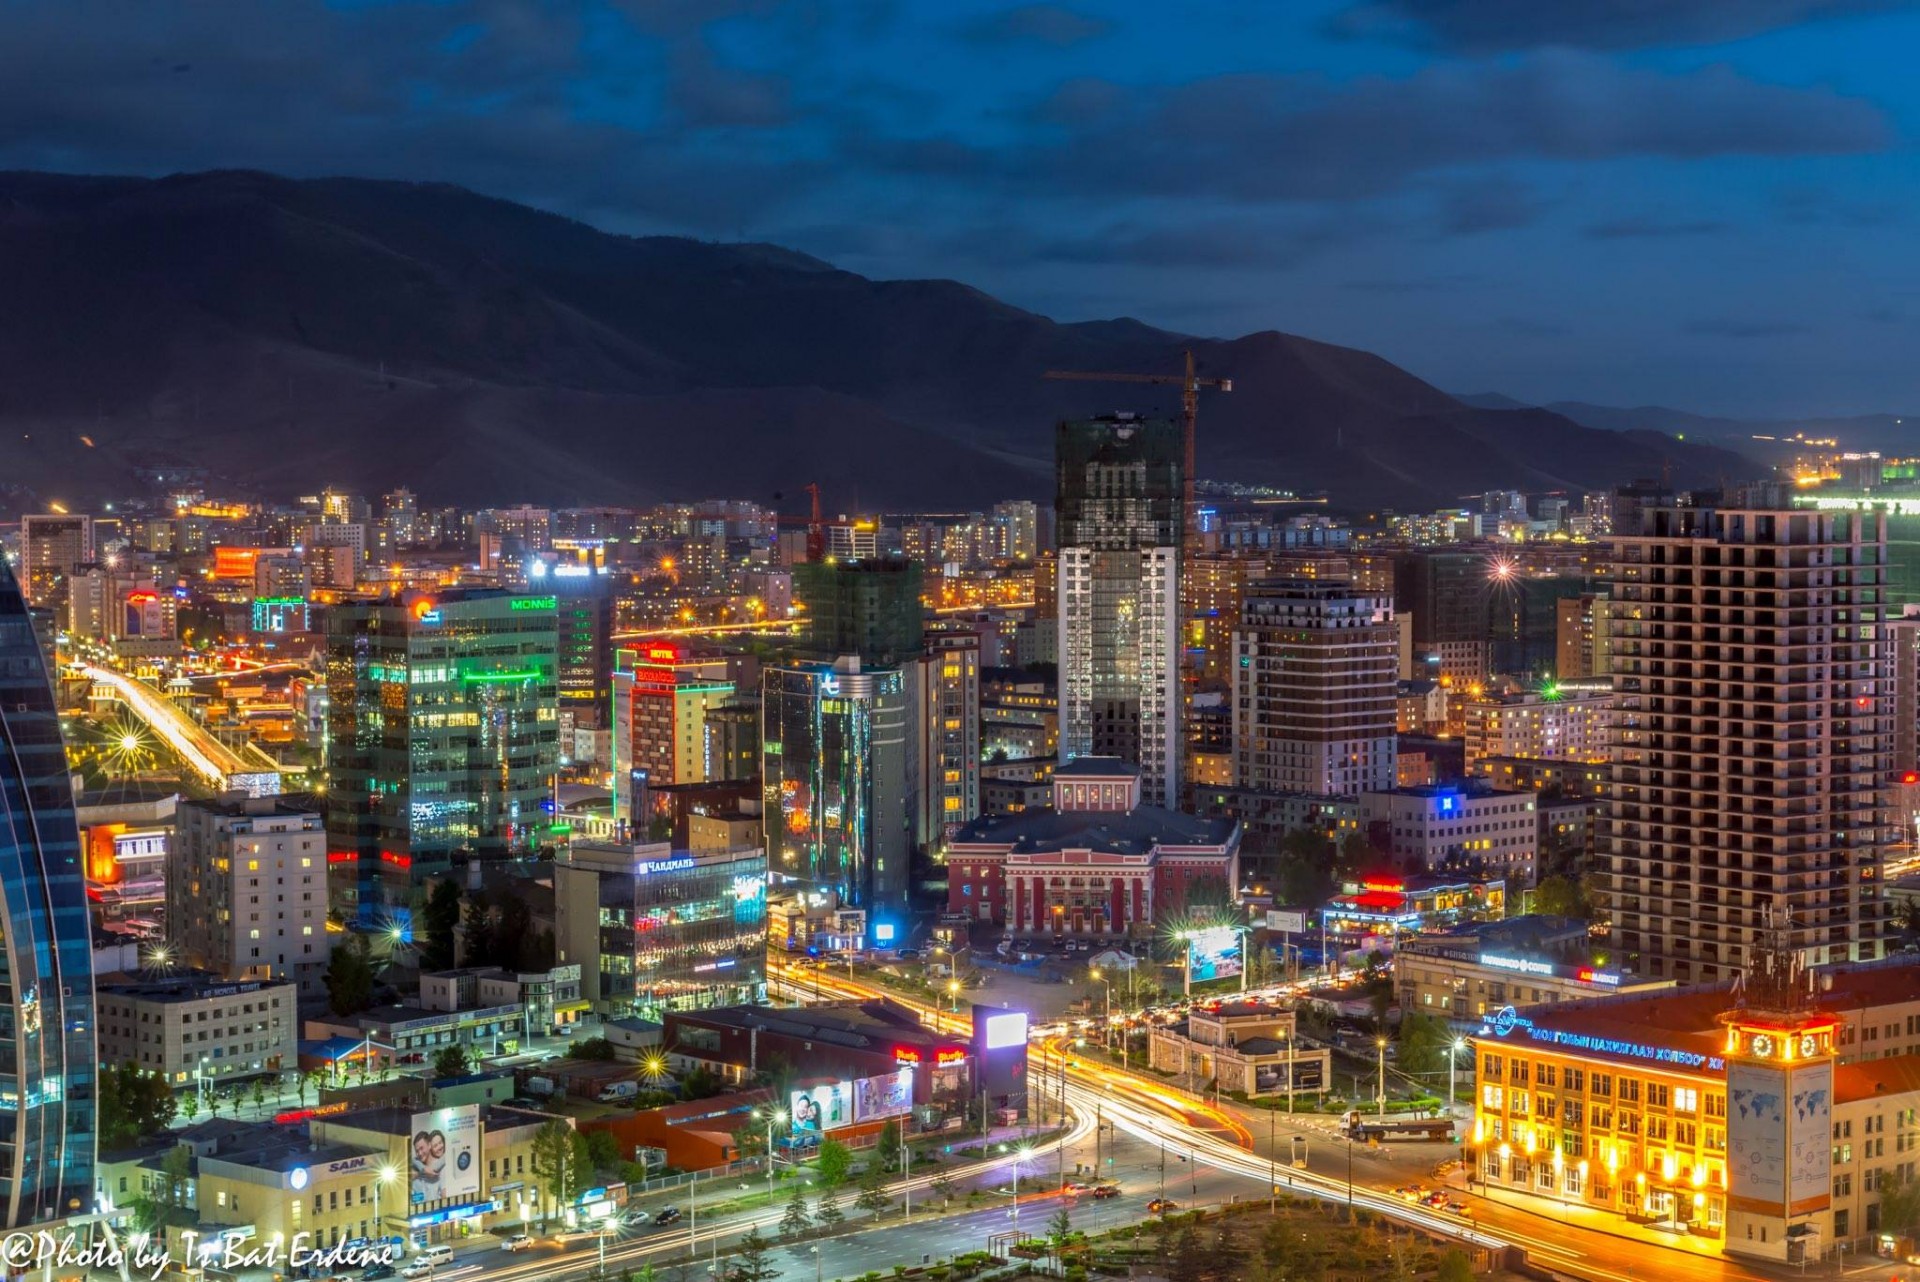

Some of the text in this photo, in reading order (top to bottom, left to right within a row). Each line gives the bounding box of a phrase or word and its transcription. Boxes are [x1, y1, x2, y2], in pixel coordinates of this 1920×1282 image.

[511, 597, 556, 610] MONNIS
[650, 649, 675, 659] HOTEL
[648, 859, 694, 871] ЧАНДМАНЬ
[1590, 1038, 1654, 1058] ЦАХИЛГААН
[938, 1050, 964, 1062] Bluefin
[329, 1158, 365, 1172] SAIN
